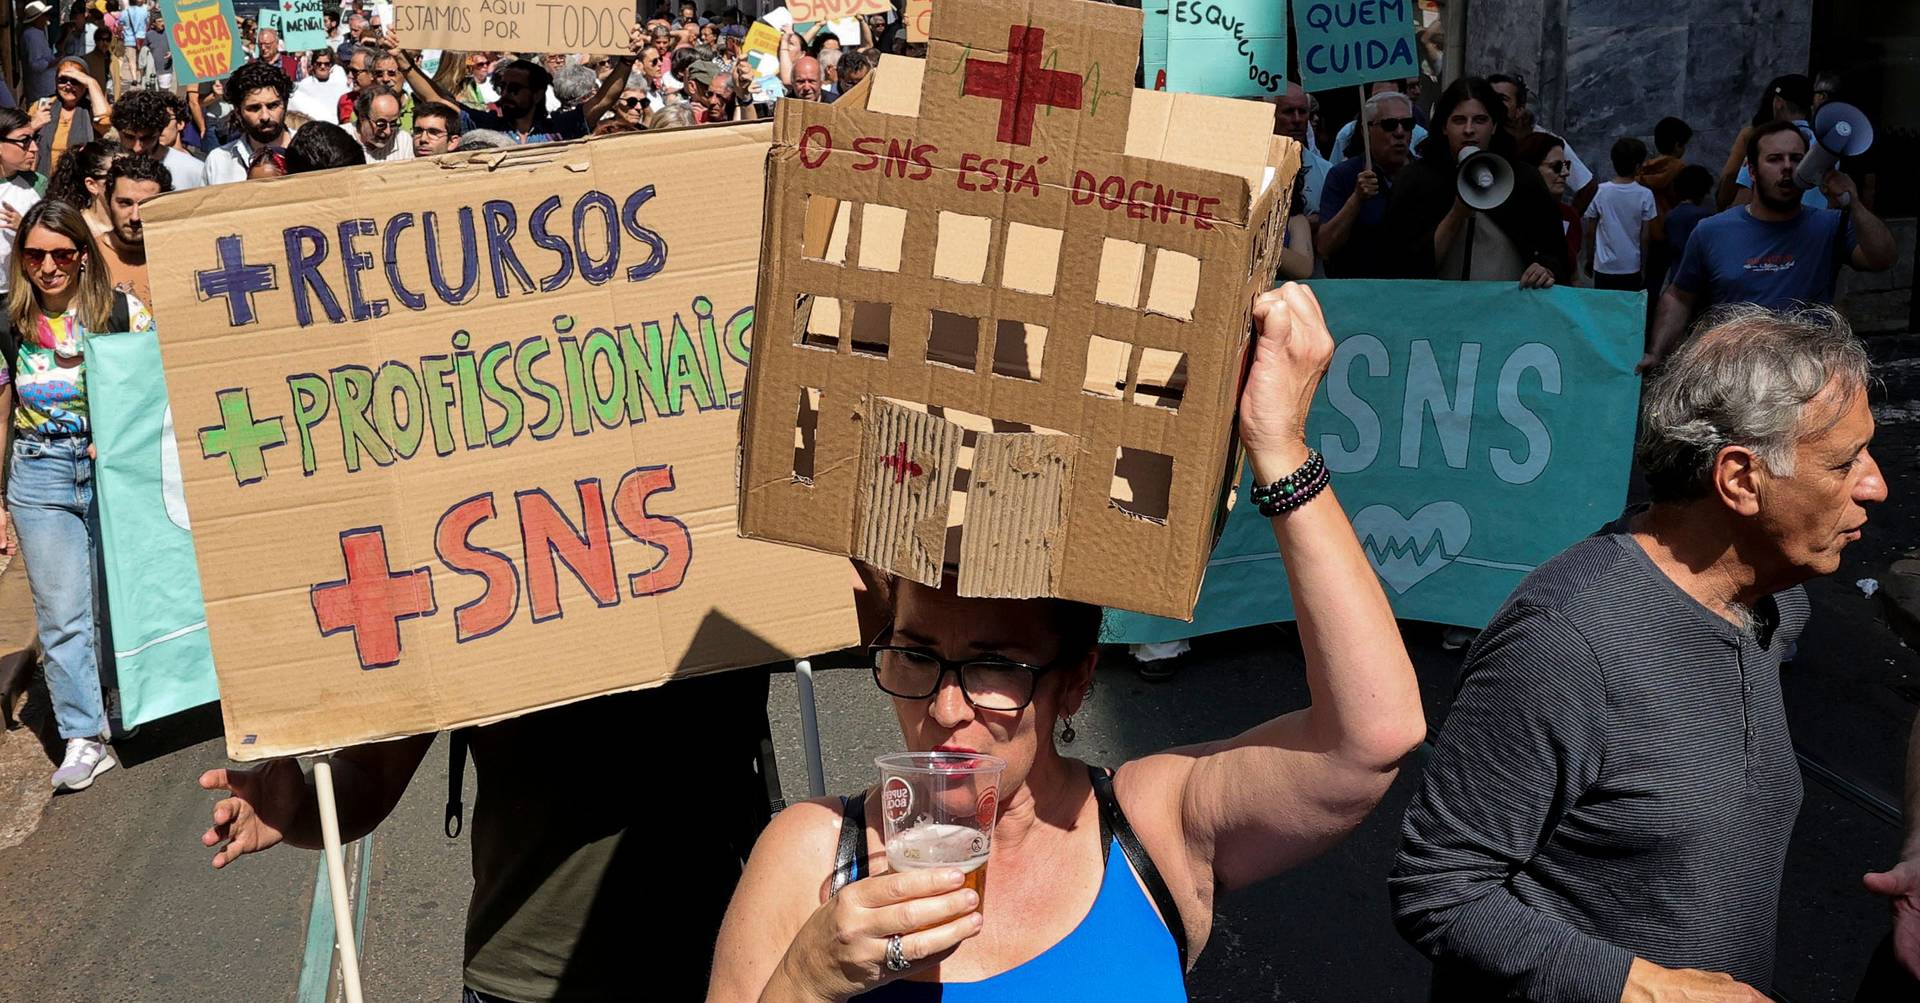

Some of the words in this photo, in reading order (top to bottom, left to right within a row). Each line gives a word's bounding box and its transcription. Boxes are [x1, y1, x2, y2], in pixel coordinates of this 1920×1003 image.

[172, 14, 231, 48] COSTA
[286, 17, 324, 32] MENTAL
[395, 5, 471, 34] ESTAMOS
[483, 20, 520, 39] POR
[536, 3, 632, 49] TODOS
[1306, 0, 1404, 33] QUEM
[1175, 1, 1283, 92] ESQUECIDOS
[1306, 37, 1413, 74] CUIDA
[193, 52, 228, 79] SNS
[799, 125, 832, 169] O
[852, 137, 938, 181] SNS
[956, 154, 1050, 197] ESTÁ
[1070, 170, 1221, 230] DOENTE
[1320, 333, 1562, 485] SNS
